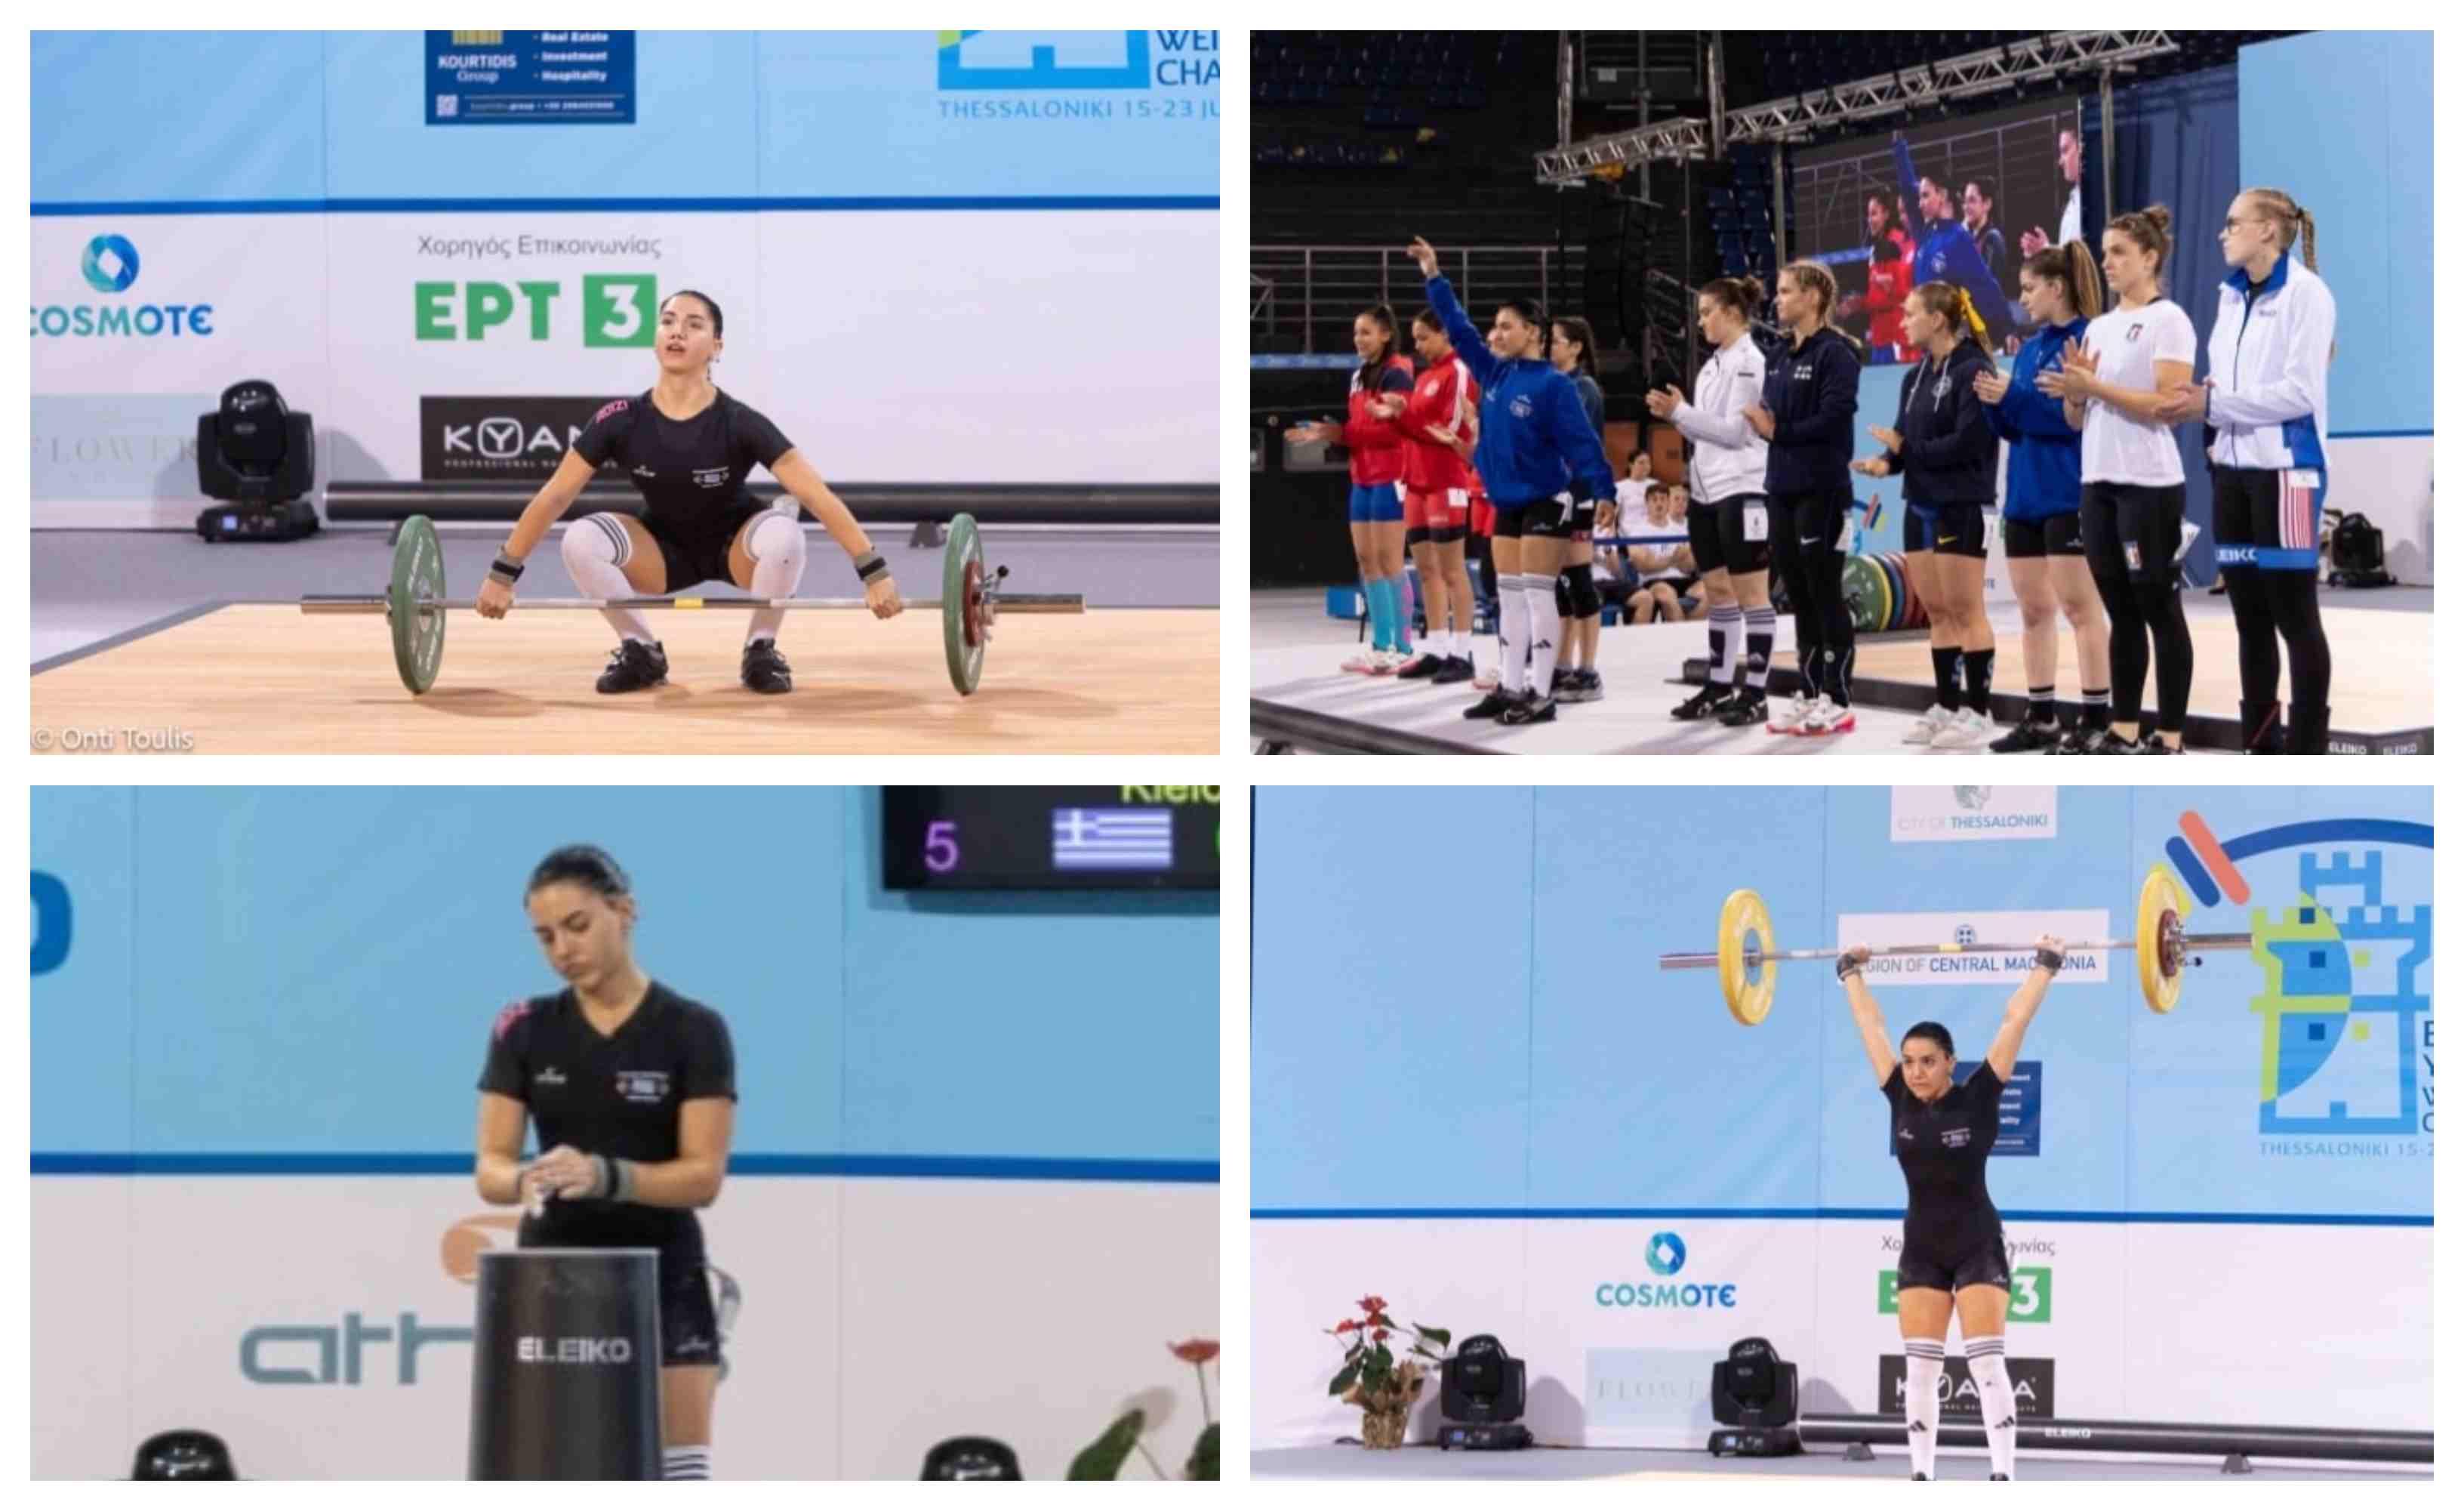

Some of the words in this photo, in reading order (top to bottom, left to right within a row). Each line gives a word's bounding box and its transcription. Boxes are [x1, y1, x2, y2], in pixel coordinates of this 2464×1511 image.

[438, 54, 518, 69] KOURTIDIS
[938, 100, 1113, 118] THESSALONIKI
[1125, 99, 1193, 118] 15-23
[417, 236, 512, 259] Χορηγός
[518, 234, 661, 259] Επικοινωνίας
[30, 304, 214, 337] OSMOTE
[1950, 813, 2049, 829] THESSALONIKI
[925, 821, 958, 871] 5
[1905, 957, 1926, 973] OF
[1930, 955, 1999, 973] CENTRAL
[2259, 1141, 2389, 1158] THESSALONIKI
[1596, 1283, 1736, 1307] COSMOTE
[516, 1336, 631, 1363] ELEIKO
